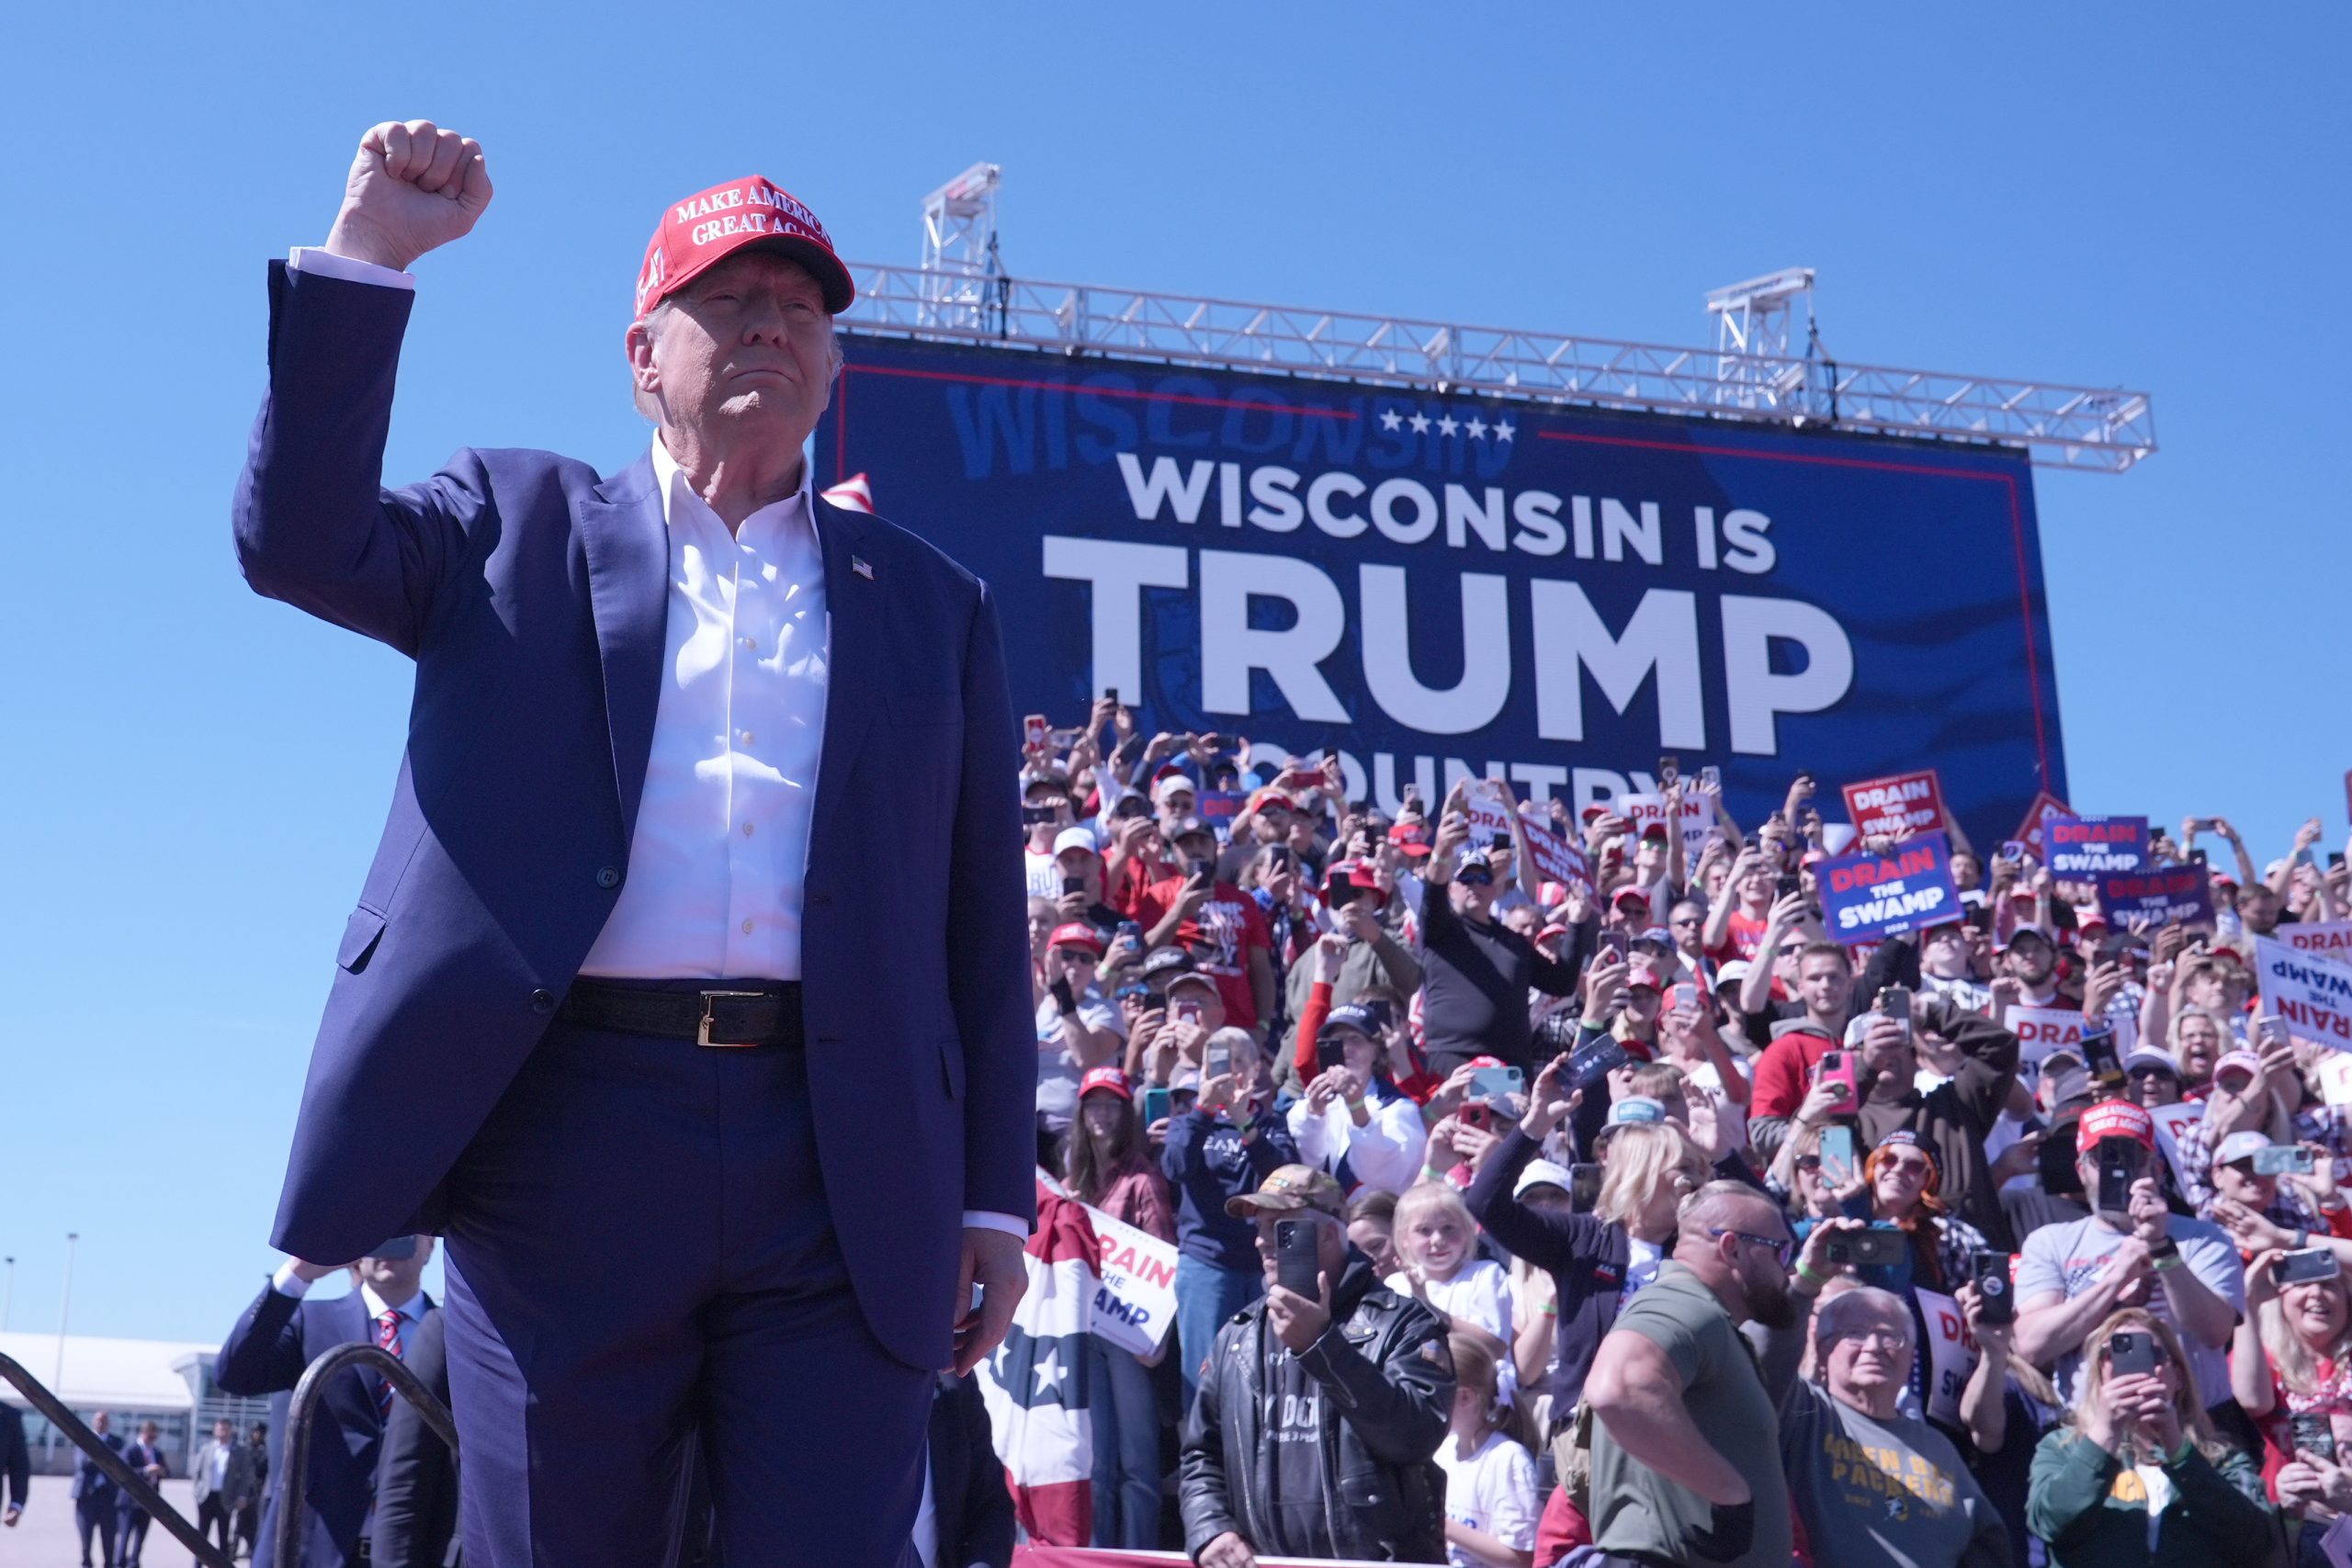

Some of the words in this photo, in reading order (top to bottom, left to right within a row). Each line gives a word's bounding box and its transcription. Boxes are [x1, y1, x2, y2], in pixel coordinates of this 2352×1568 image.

[675, 188, 743, 224] MAKE
[692, 213, 767, 245] GREAT
[1116, 453, 1663, 564] WISCONSIN
[1694, 506, 1776, 574] IS
[1043, 536, 1853, 755] TRUMP
[1853, 779, 1929, 811] DRAIN
[1882, 803, 1906, 816] THE
[1862, 808, 1936, 835] SWAMP
[2053, 825, 2137, 843] DRAIN
[2053, 854, 2139, 872] SWAMP
[2081, 843, 2109, 854] THE
[1830, 847, 1935, 893] DRAIN
[2107, 874, 2197, 897] DRAIN
[1870, 880, 1905, 900] THE
[2139, 896, 2168, 908] THE
[1838, 886, 1945, 929] SWAMP
[2112, 902, 2200, 927] SWAMP
[2273, 961, 2352, 998] WAMP
[2277, 996, 2351, 1039] RAIN
[1099, 1234, 1176, 1290] RAIN
[1094, 1288, 1150, 1326] AMP
